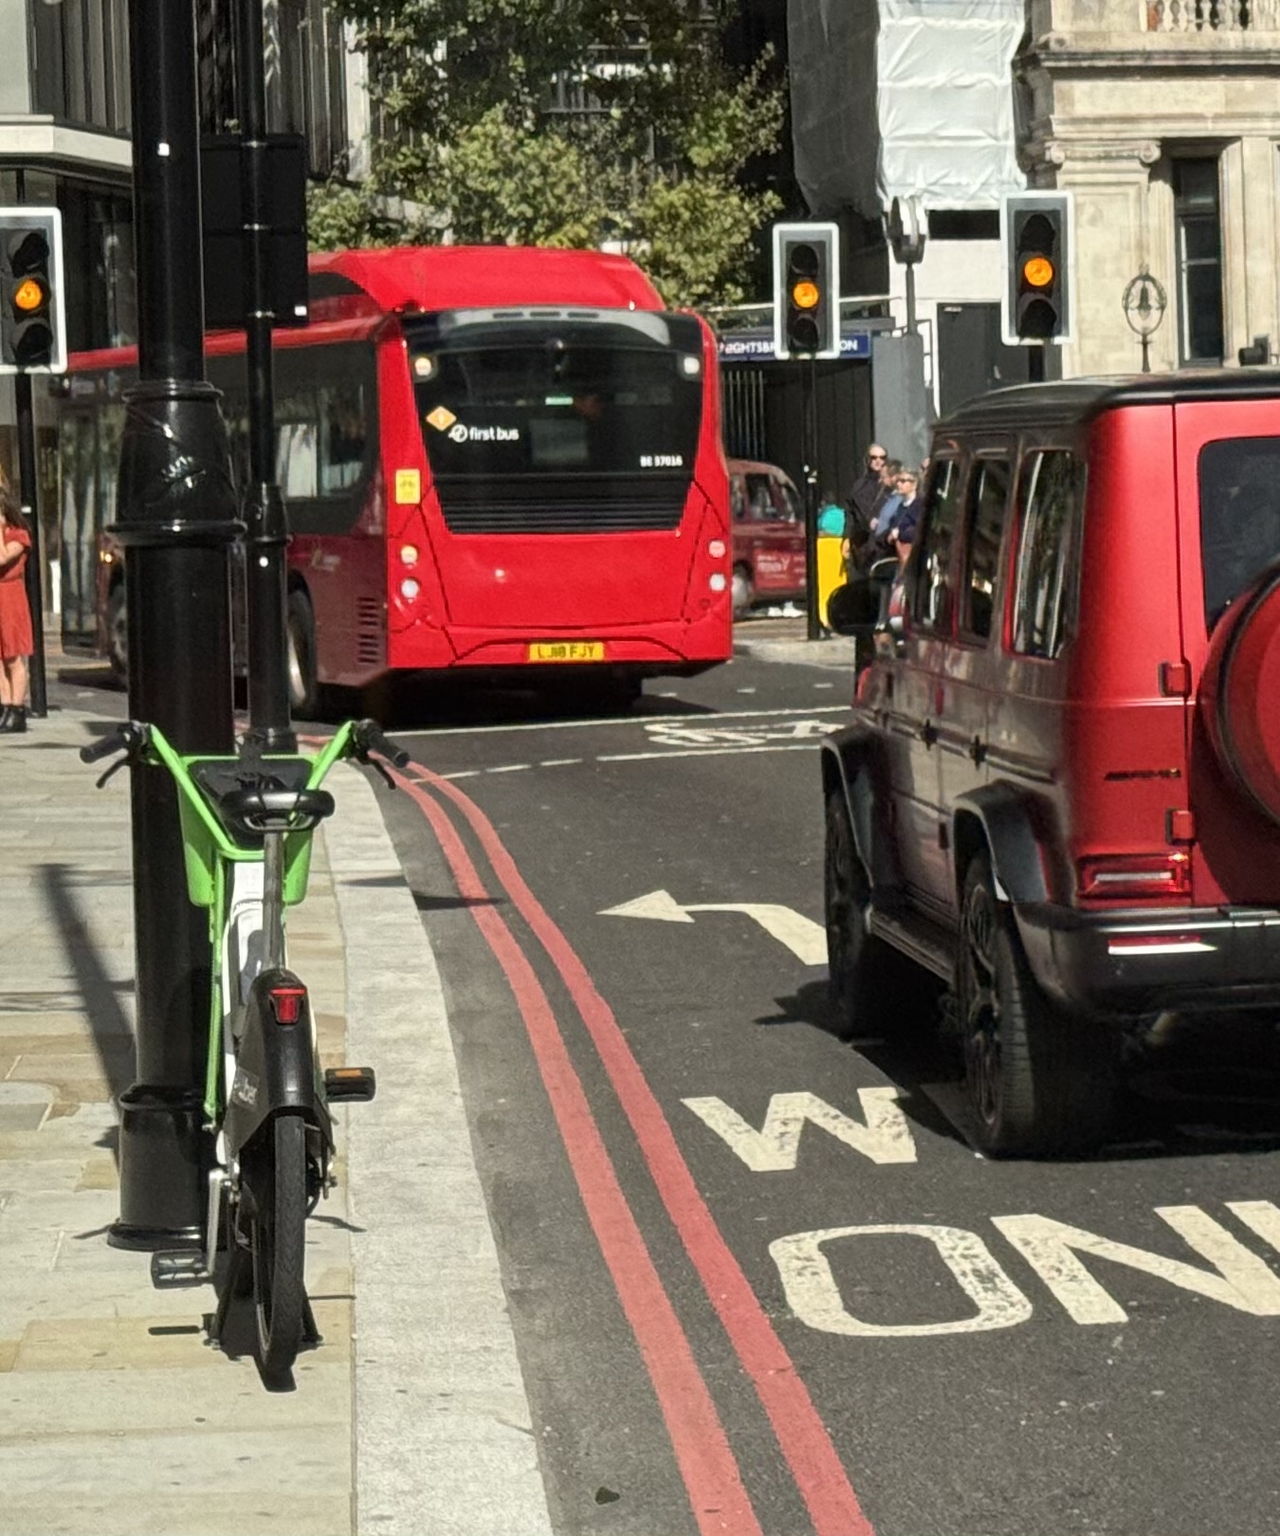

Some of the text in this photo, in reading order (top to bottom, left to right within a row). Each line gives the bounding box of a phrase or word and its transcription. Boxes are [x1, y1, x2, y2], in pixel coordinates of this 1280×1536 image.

[469, 426, 520, 441] first bus
[569, 645, 596, 658] FJY
